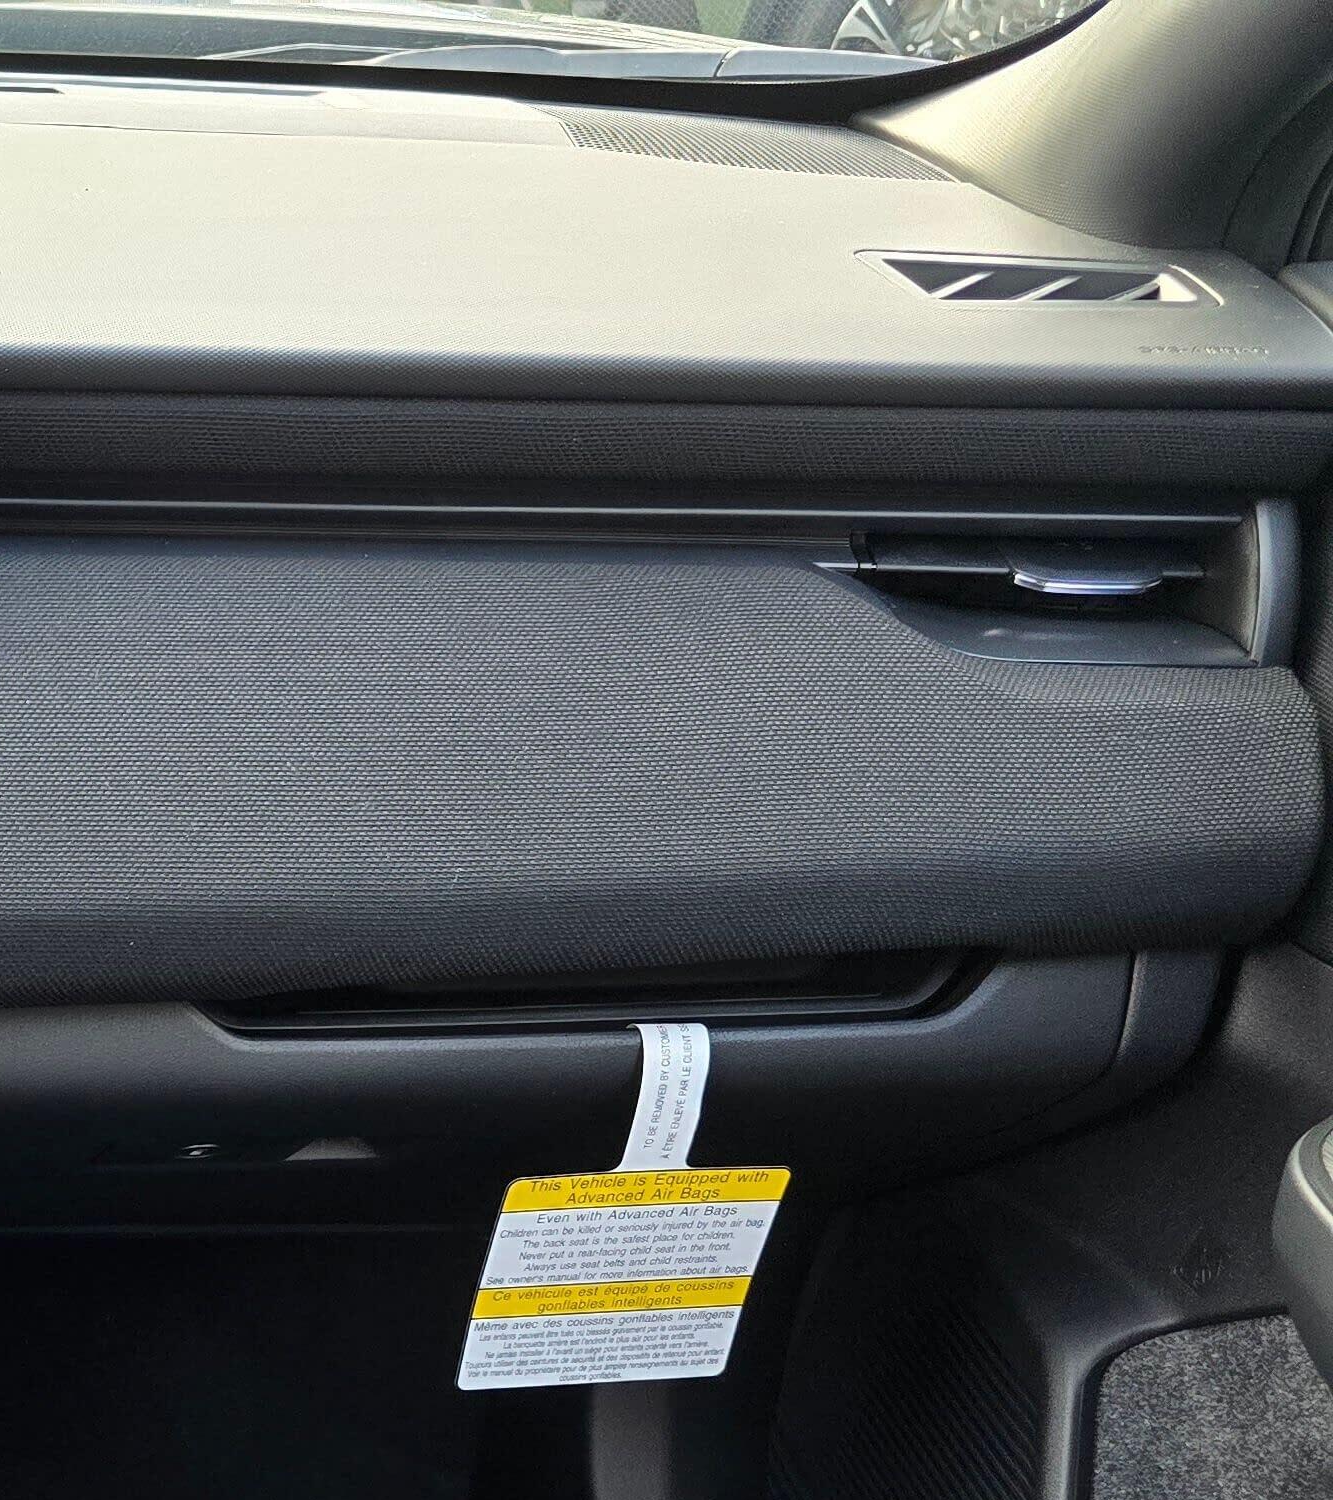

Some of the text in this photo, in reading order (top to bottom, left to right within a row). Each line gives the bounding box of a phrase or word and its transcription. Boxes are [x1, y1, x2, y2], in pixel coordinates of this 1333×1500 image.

[683, 1034, 693, 1064] CLIENT
[660, 1070, 669, 1081] BY
[682, 1066, 691, 1077] LE
[678, 1080, 689, 1096] PAR
[648, 1125, 658, 1136] BE
[644, 1138, 654, 1149] TO
[531, 1171, 769, 1192] This Vehicle is Equipped with
[565, 1187, 720, 1204] Advanced Air Bags
[537, 1206, 738, 1224] Even with Advanced Air Bags
[500, 1229, 539, 1239] Children
[562, 1226, 574, 1235] be
[578, 1225, 602, 1234] killed
[663, 1219, 693, 1231] injured
[697, 1218, 709, 1229] by
[712, 1218, 726, 1228] the
[523, 1240, 540, 1248] The
[543, 1239, 565, 1248] back
[568, 1237, 589, 1246] seat
[603, 1235, 619, 1244] the
[621, 1233, 651, 1244] safest
[652, 1234, 678, 1244] place
[681, 1232, 694, 1241] for
[519, 1251, 546, 1260] Never
[548, 1250, 565, 1260] put
[577, 1246, 627, 1258] rear-facing
[629, 1245, 652, 1254] child
[654, 1244, 675, 1253] seat
[689, 1242, 706, 1251] the
[523, 1263, 557, 1272] Always
[559, 1262, 577, 1270] use
[579, 1260, 600, 1269] seat
[603, 1258, 625, 1268] belts
[628, 1257, 647, 1266] and
[649, 1255, 672, 1265] child
[486, 1275, 504, 1285] See
[546, 1271, 581, 1281] manual
[583, 1269, 597, 1279] for
[599, 1269, 623, 1279] more
[626, 1267, 677, 1278] information
[679, 1265, 707, 1275] about
[708, 1265, 722, 1274] air
[492, 1290, 512, 1301] Ce
[578, 1286, 599, 1296] est
[654, 1282, 671, 1293] de
[676, 1279, 735, 1292] coussins
[537, 1294, 683, 1314] gonflables intelligents
[513, 1320, 539, 1330] avec
[543, 1319, 563, 1328] des
[566, 1315, 614, 1327] coussins
[618, 1312, 674, 1327] gonflables
[678, 1309, 735, 1321] intelligents
